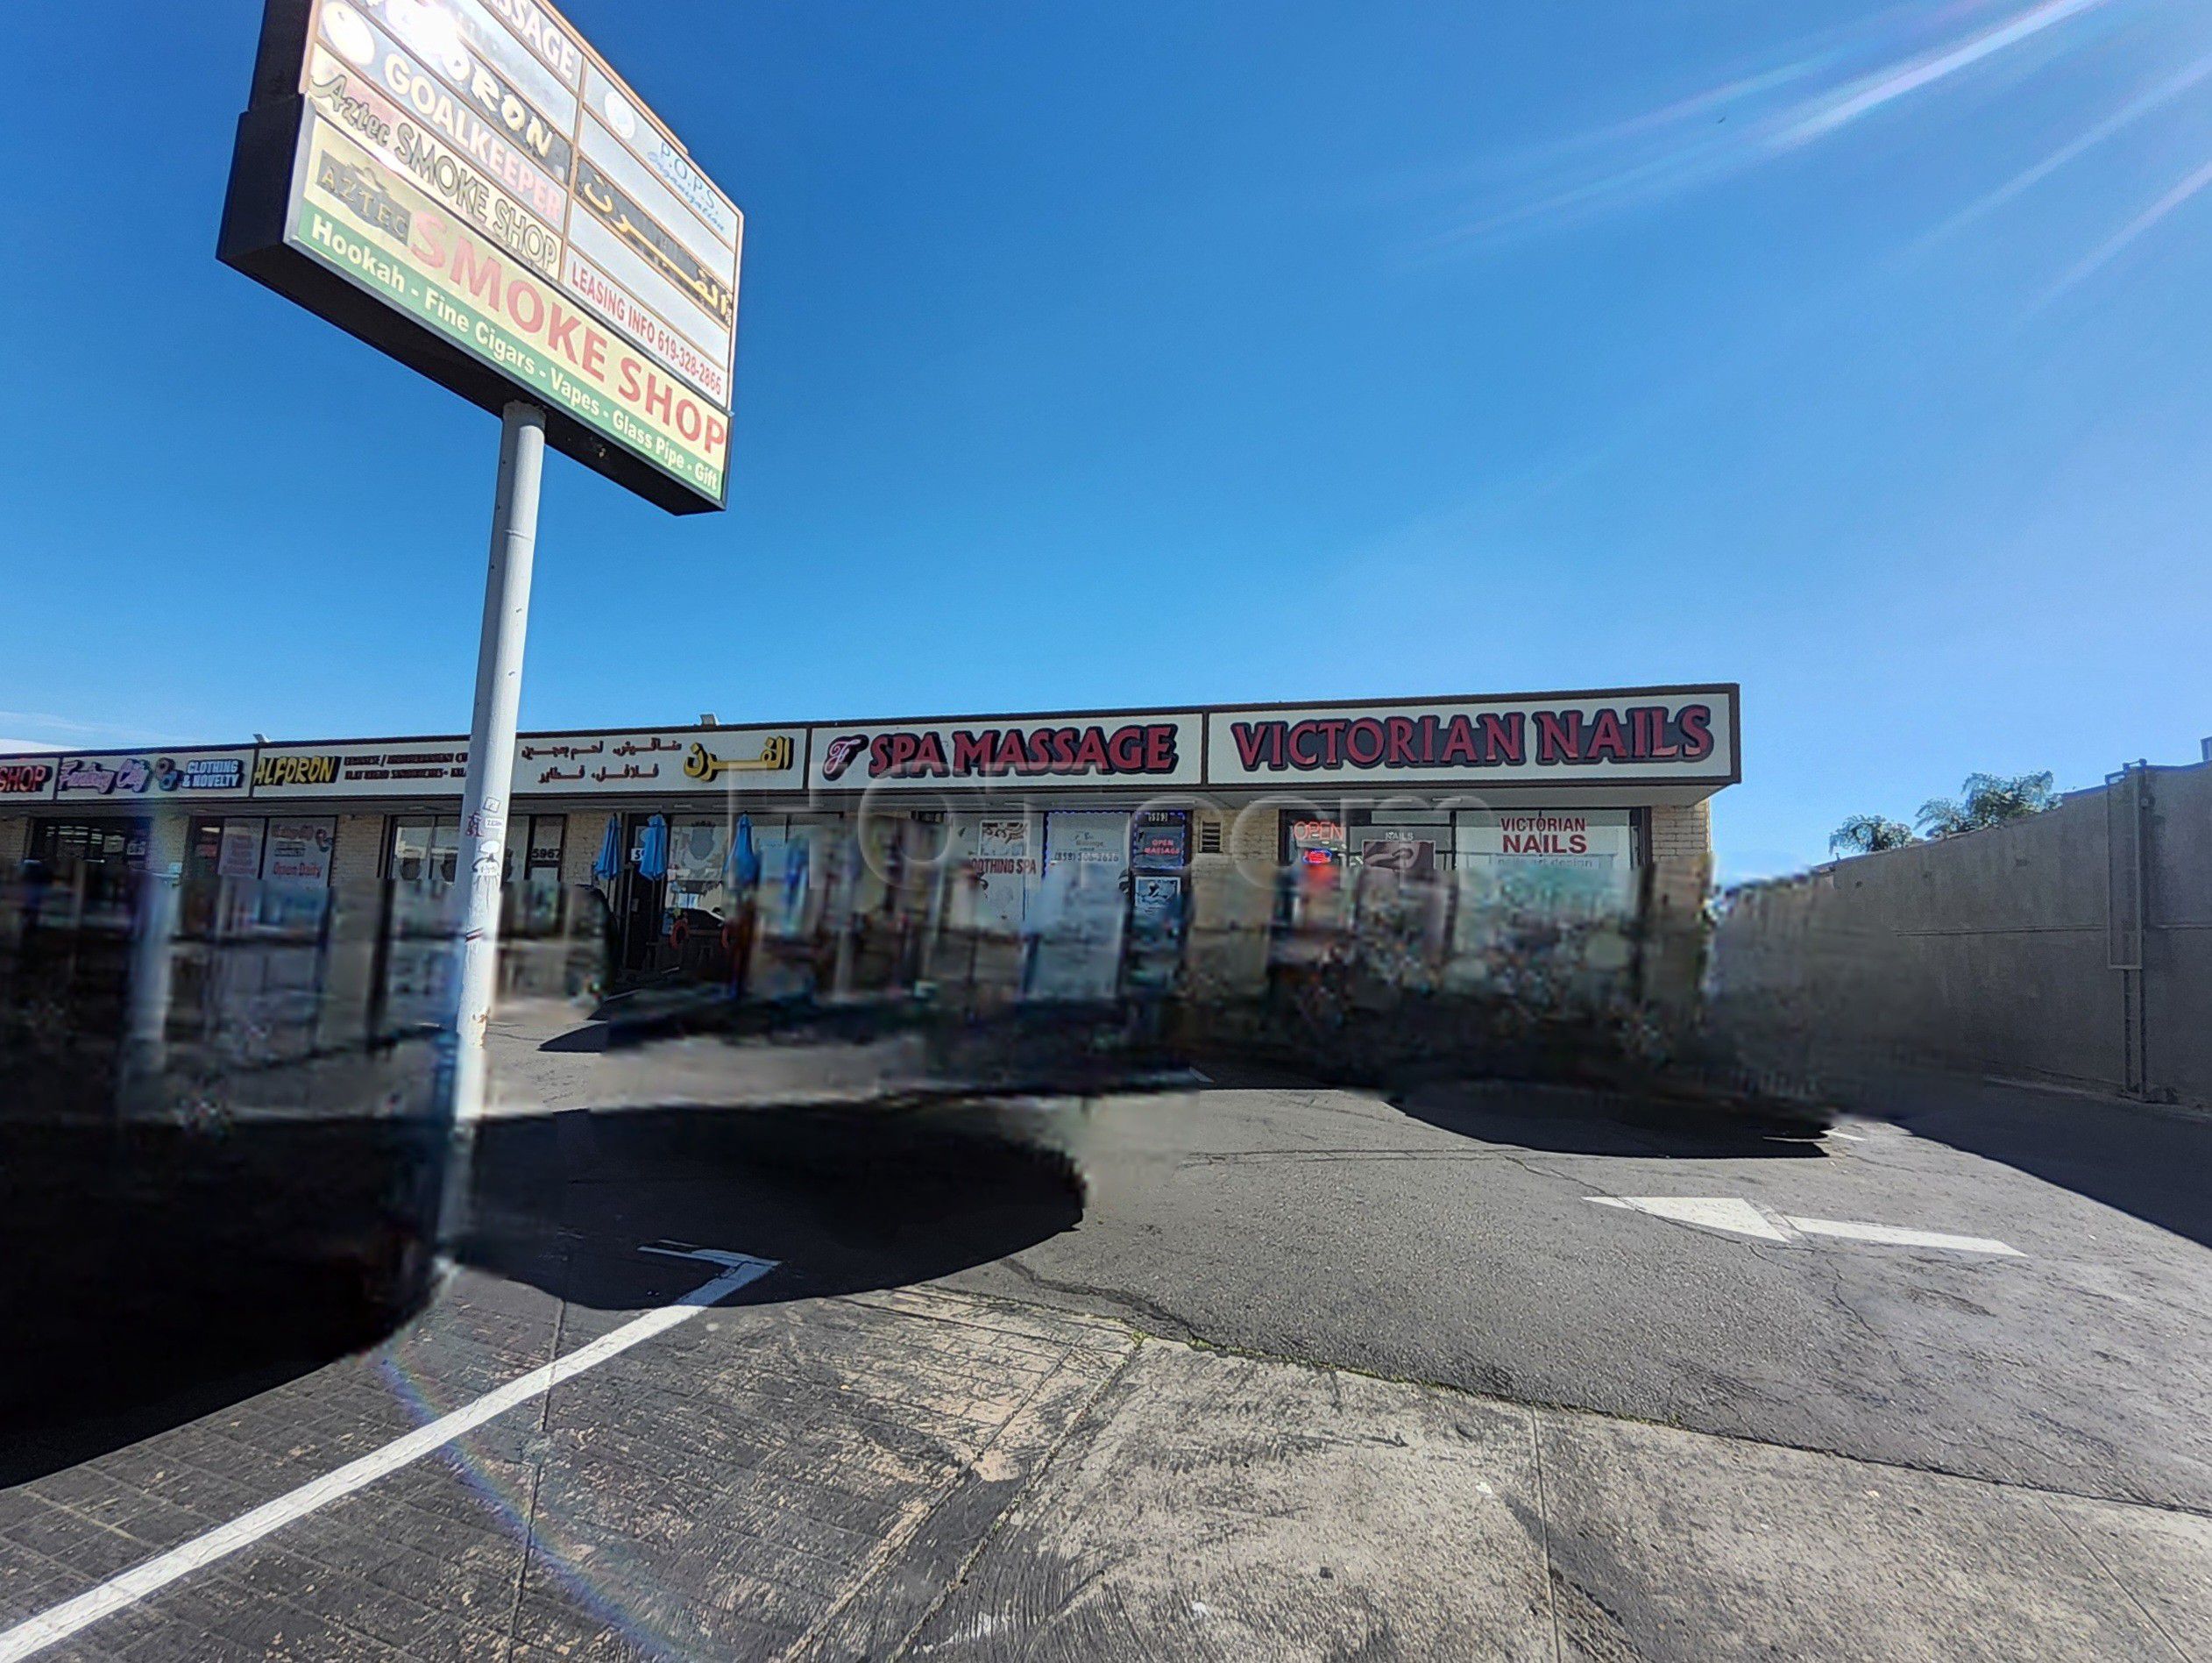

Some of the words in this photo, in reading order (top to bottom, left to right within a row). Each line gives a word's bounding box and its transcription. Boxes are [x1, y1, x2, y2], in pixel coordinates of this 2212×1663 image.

[386, 53, 561, 221] GOALKEEPER
[312, 74, 391, 147] Aztec
[394, 123, 490, 224] SMOKE
[493, 199, 557, 272] SHOP
[321, 166, 408, 236] AZTEC
[572, 261, 626, 323] LEASING
[629, 305, 656, 345] INFO
[408, 211, 608, 384] SMOKE
[619, 357, 726, 454] SHOP
[311, 212, 405, 292] Hookah
[425, 286, 470, 332] Fine
[474, 320, 535, 377] Cigars
[551, 366, 600, 416] Vapes
[613, 409, 653, 451] Glass
[656, 437, 684, 473] Pipe
[694, 461, 718, 491] Gift
[868, 733, 948, 777] SPA
[953, 726, 1175, 774] MASSAGE
[1230, 714, 1527, 771] VICTORIAN
[1532, 704, 1715, 765] NAILS
[0, 764, 49, 792] SHOP
[182, 775, 191, 788] &
[193, 772, 241, 788] NOVELTY
[187, 759, 241, 774] CLOTHING
[254, 756, 340, 785] ALFORON
[1293, 821, 1344, 842] OPEN
[1386, 831, 1414, 841] NAILS
[1500, 817, 1585, 832] VICTORIAN
[1502, 835, 1588, 854] NAILS
[969, 857, 1014, 874] OOTHING
[1016, 858, 1037, 875] SPA
